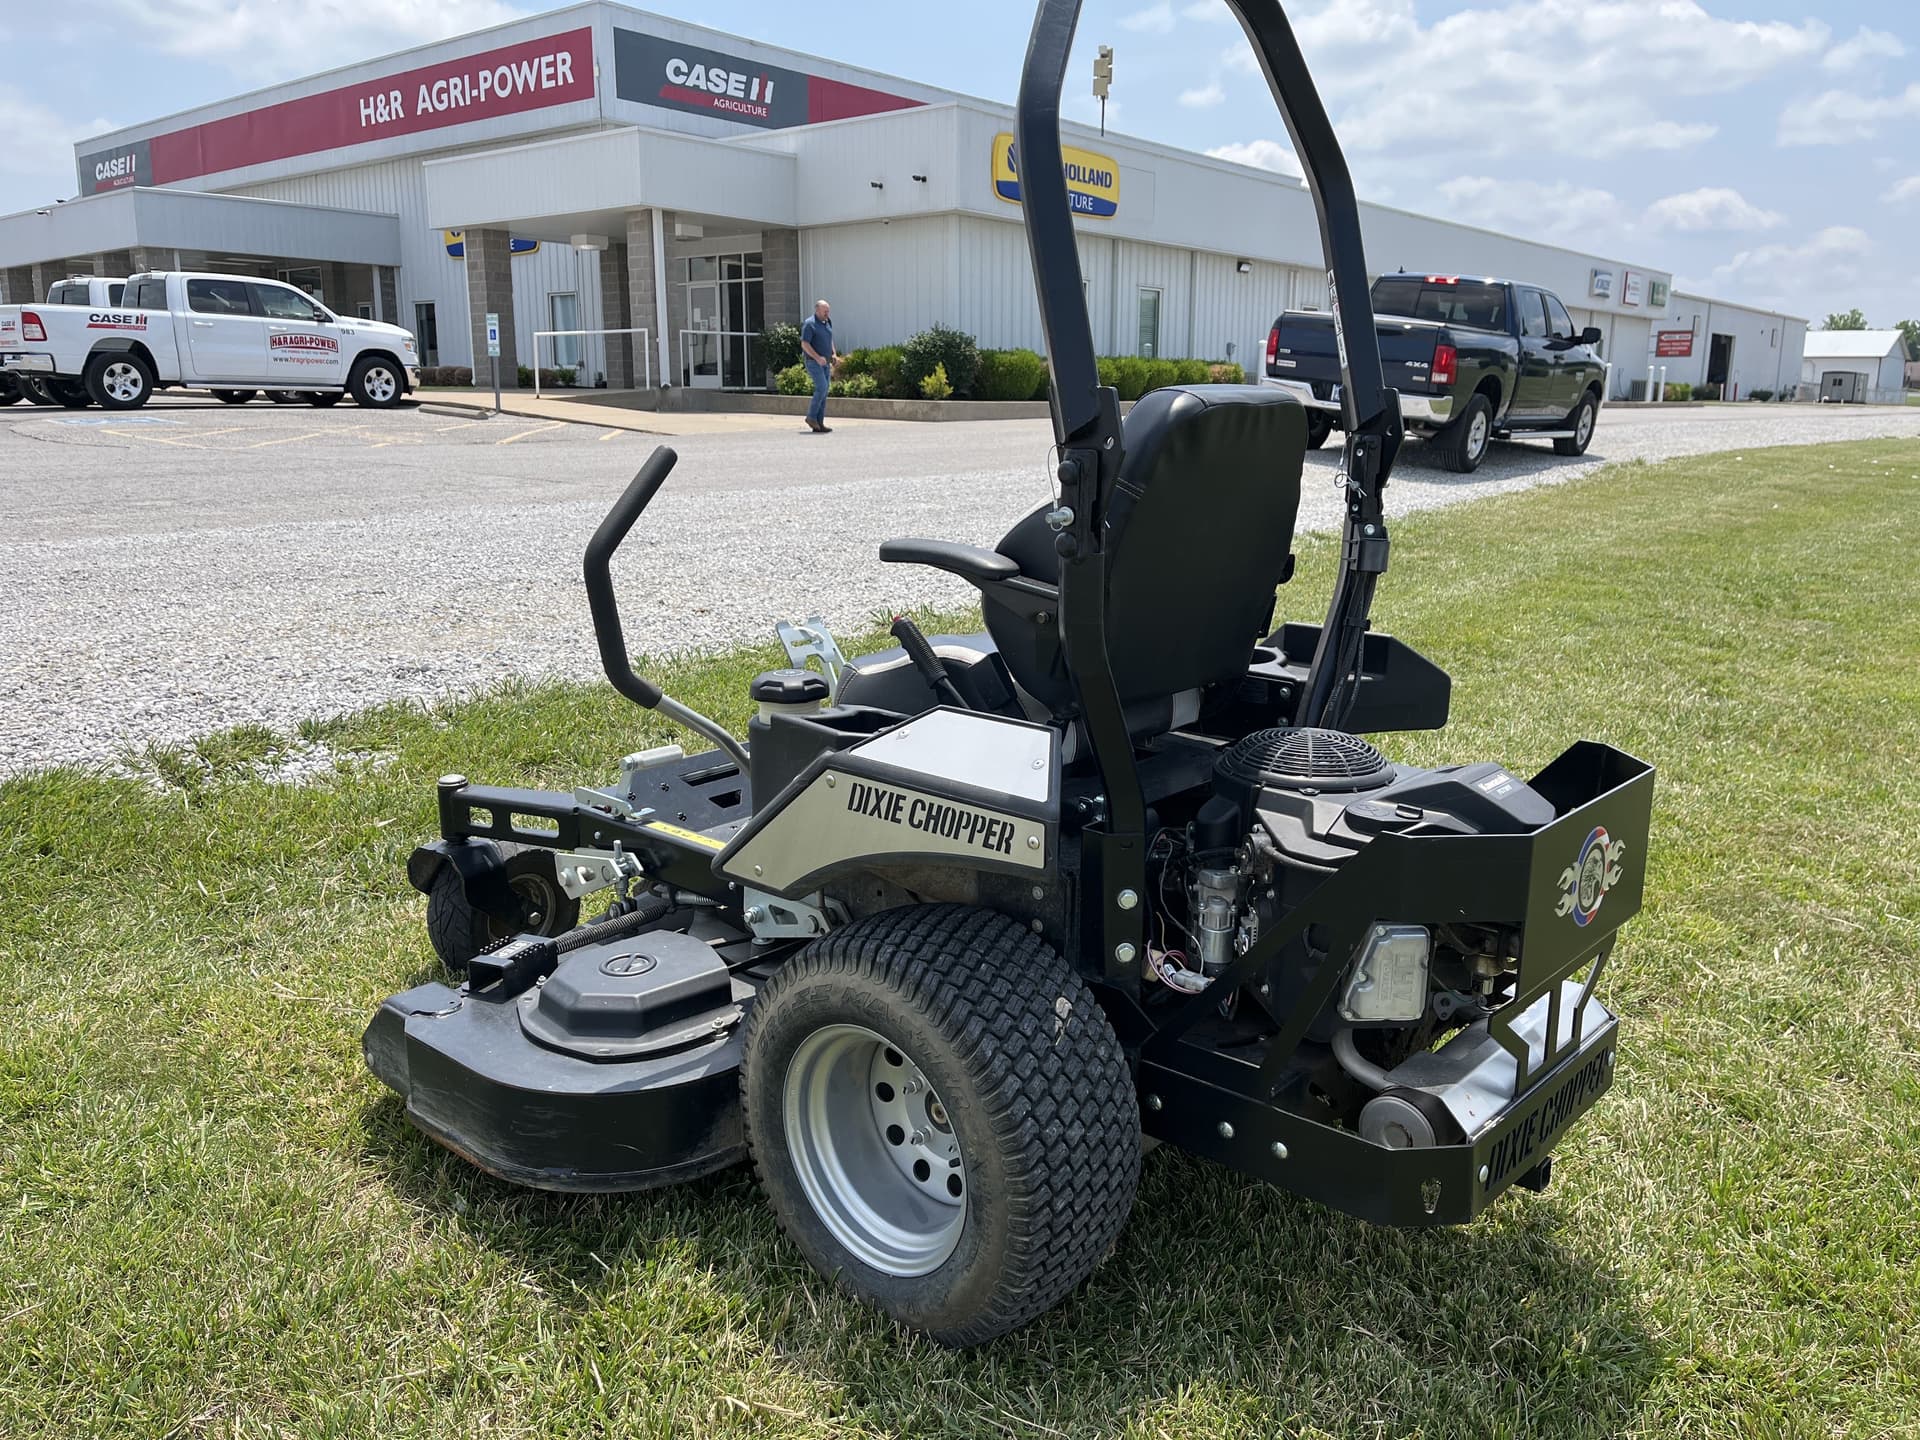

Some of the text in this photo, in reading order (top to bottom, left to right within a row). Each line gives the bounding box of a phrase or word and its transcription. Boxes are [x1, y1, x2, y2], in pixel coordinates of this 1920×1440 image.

[359, 51, 575, 127] H&R AGRI-POWER
[665, 57, 747, 97] CASE
[713, 97, 768, 117] AGRICULTURE
[95, 156, 126, 181] CASE
[89, 313, 132, 324] CASE
[847, 782, 1016, 856] DIXIE CHOPPER
[1485, 1046, 1610, 1192] DIXIE CHOPPER
